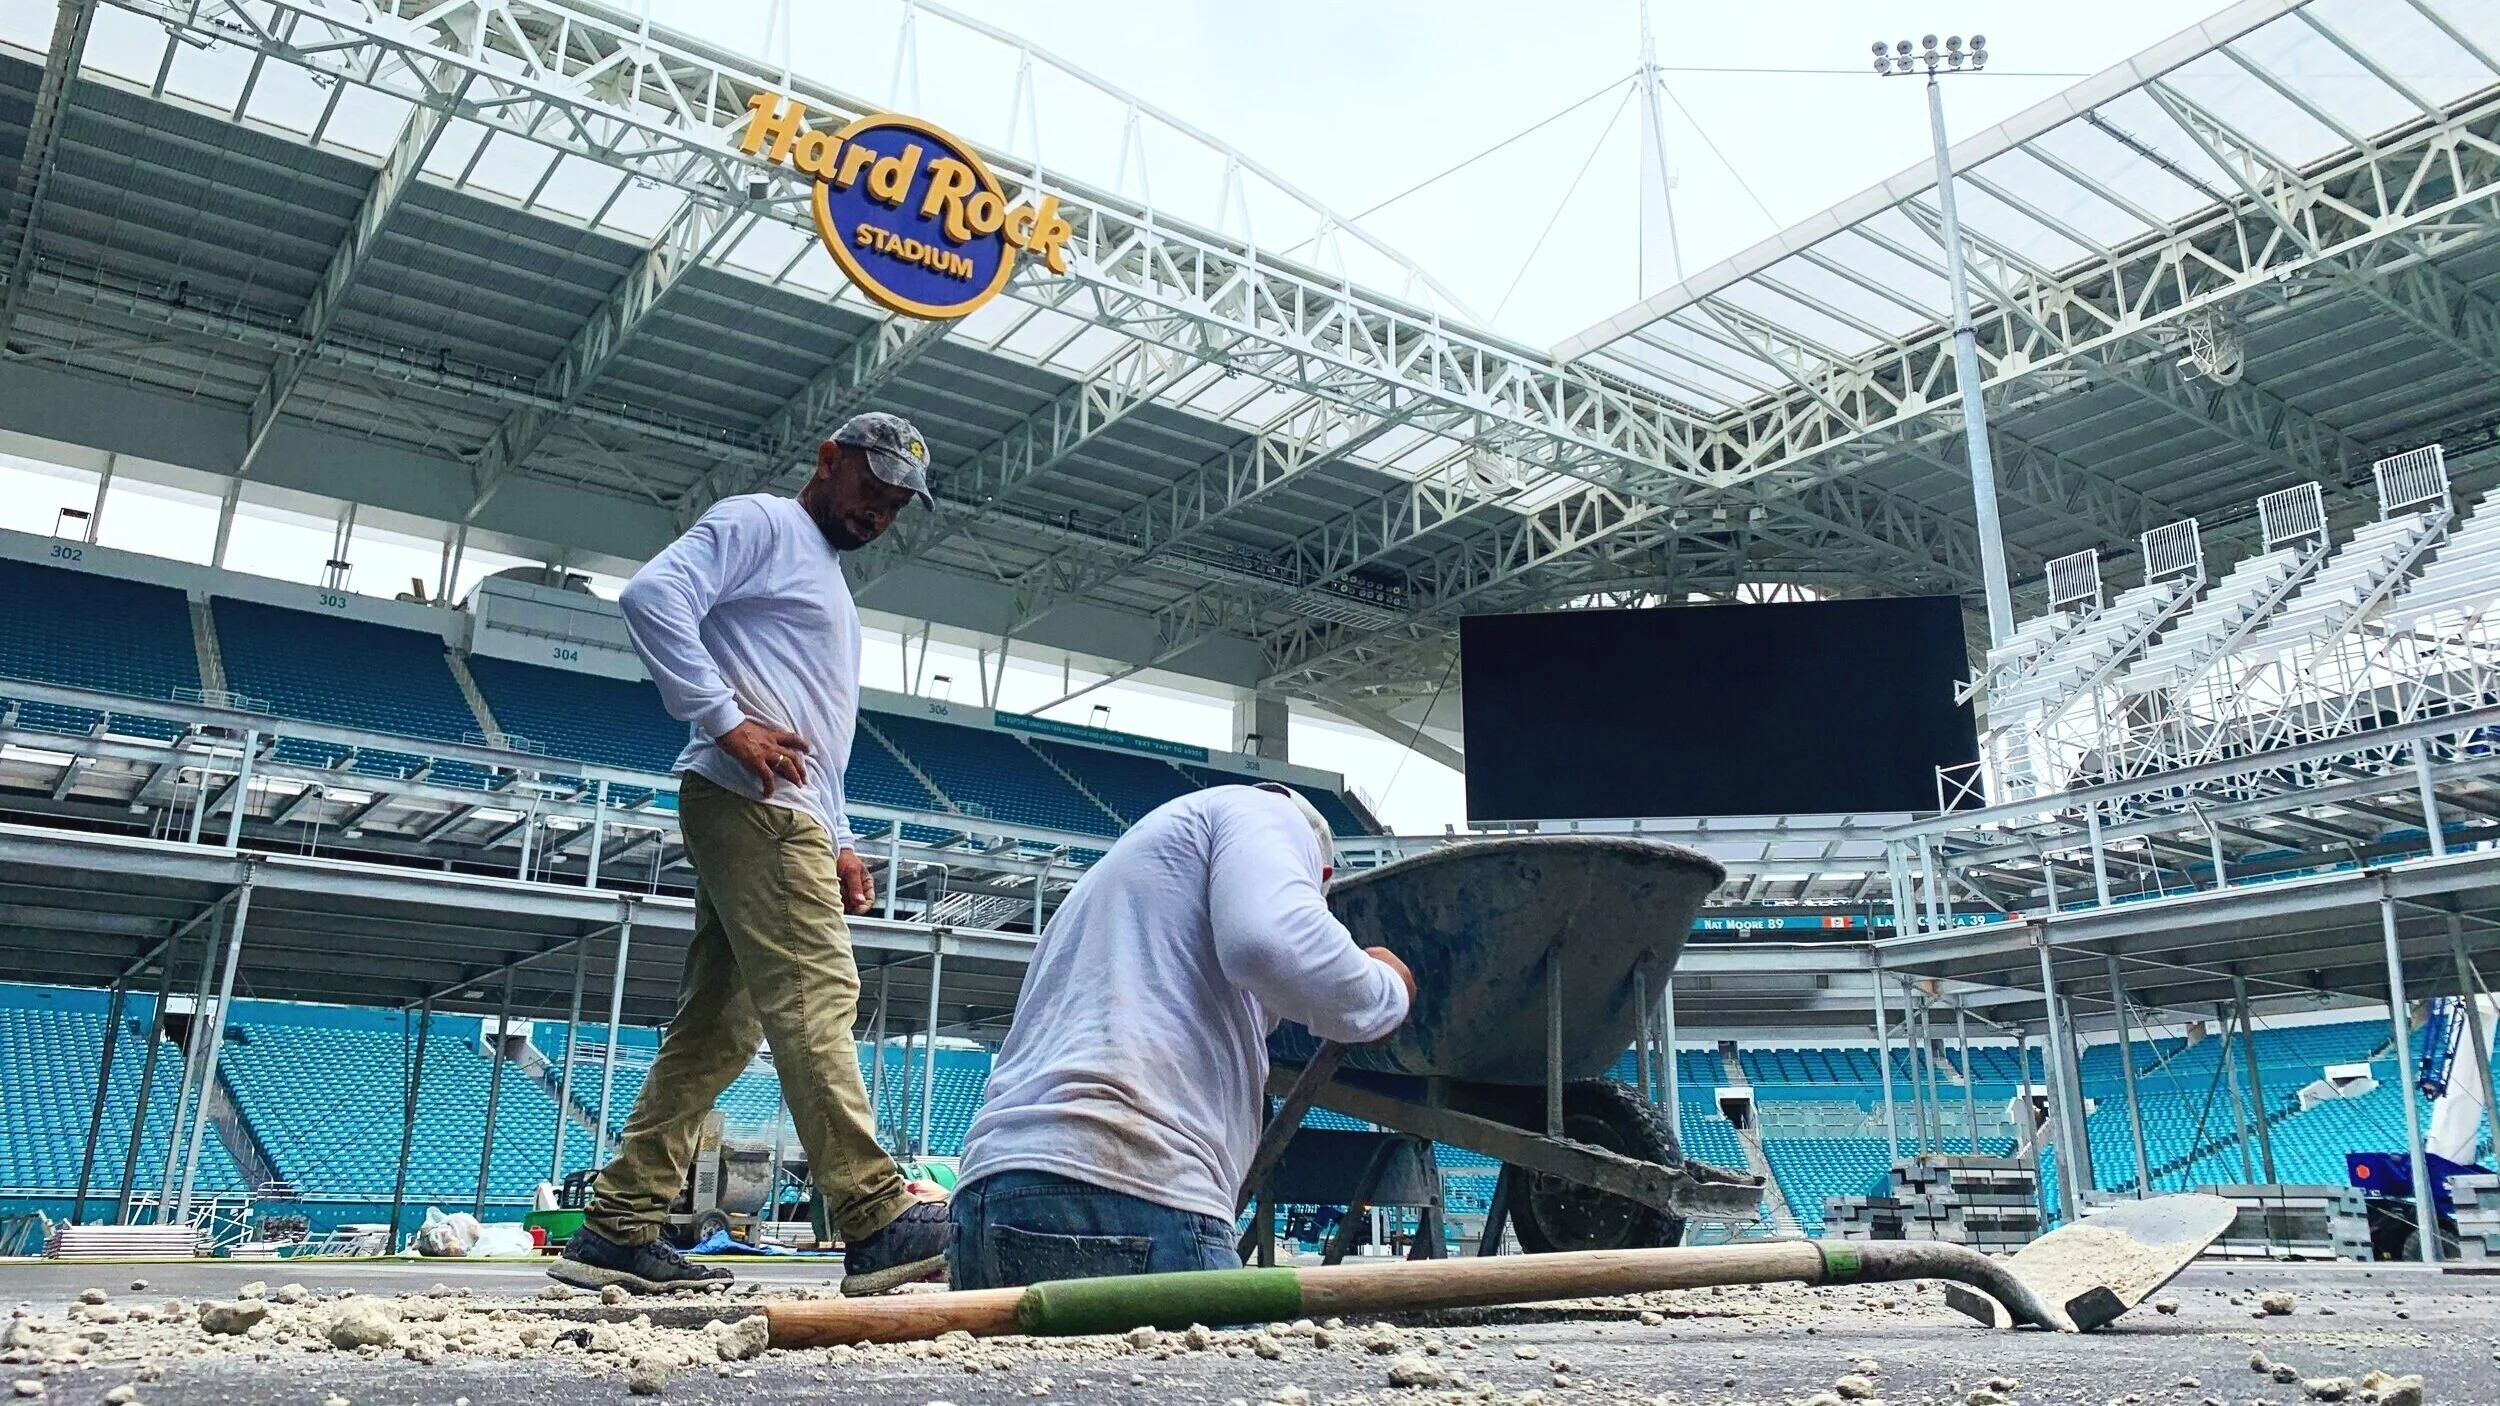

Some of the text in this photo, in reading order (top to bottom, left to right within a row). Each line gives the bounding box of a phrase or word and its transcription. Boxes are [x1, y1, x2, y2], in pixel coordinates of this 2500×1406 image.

[739, 91, 1073, 276] Hard Rock
[856, 222, 974, 281] STADIUM
[50, 545, 83, 562] 302
[319, 594, 347, 609] 303
[553, 647, 578, 662] 304
[929, 703, 949, 716] 306
[1134, 739, 1151, 749] TEXT
[1704, 918, 1785, 930] NAT MOORE 89
[1969, 914, 1987, 927] 39
